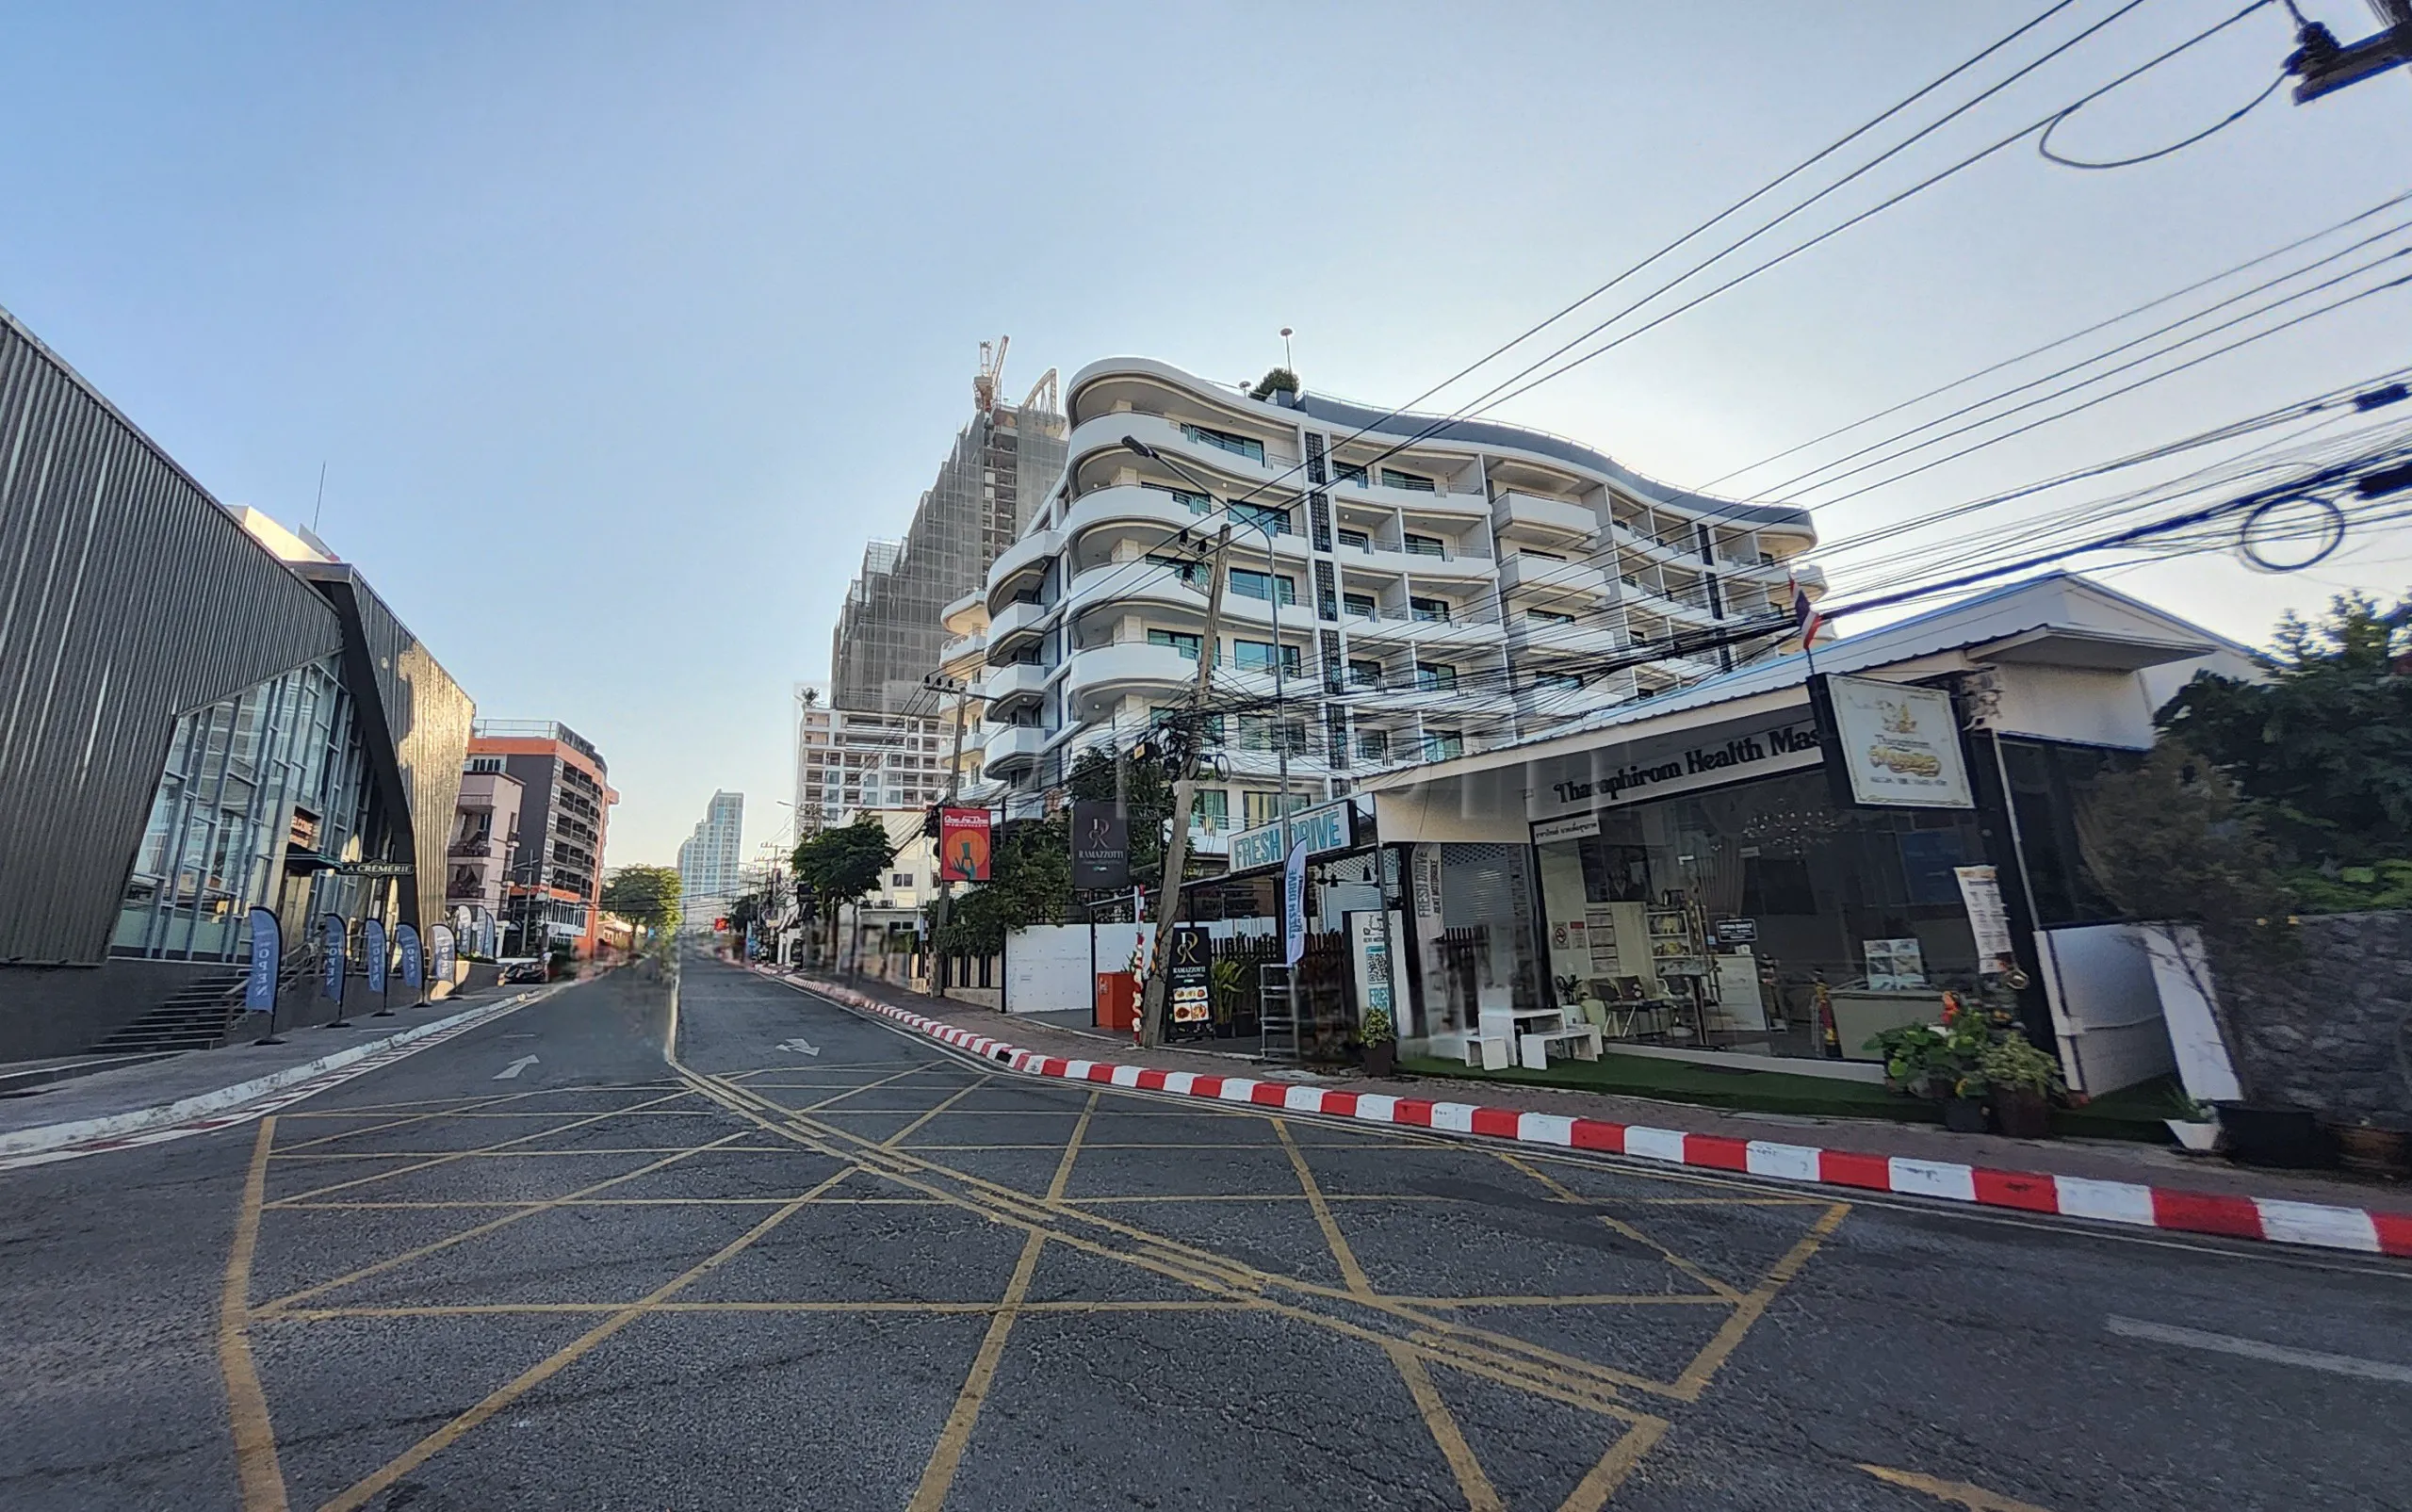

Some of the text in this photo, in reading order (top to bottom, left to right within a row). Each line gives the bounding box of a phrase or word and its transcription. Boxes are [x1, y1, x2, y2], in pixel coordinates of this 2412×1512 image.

[1685, 737, 1766, 775] Health
[1768, 726, 1821, 756] Mas
[1078, 850, 1124, 859] RAMAZZOTTI
[1234, 828, 1282, 870] FRESH
[1288, 868, 1297, 902] DRIVE
[1414, 851, 1431, 919] FRESH DRIVE
